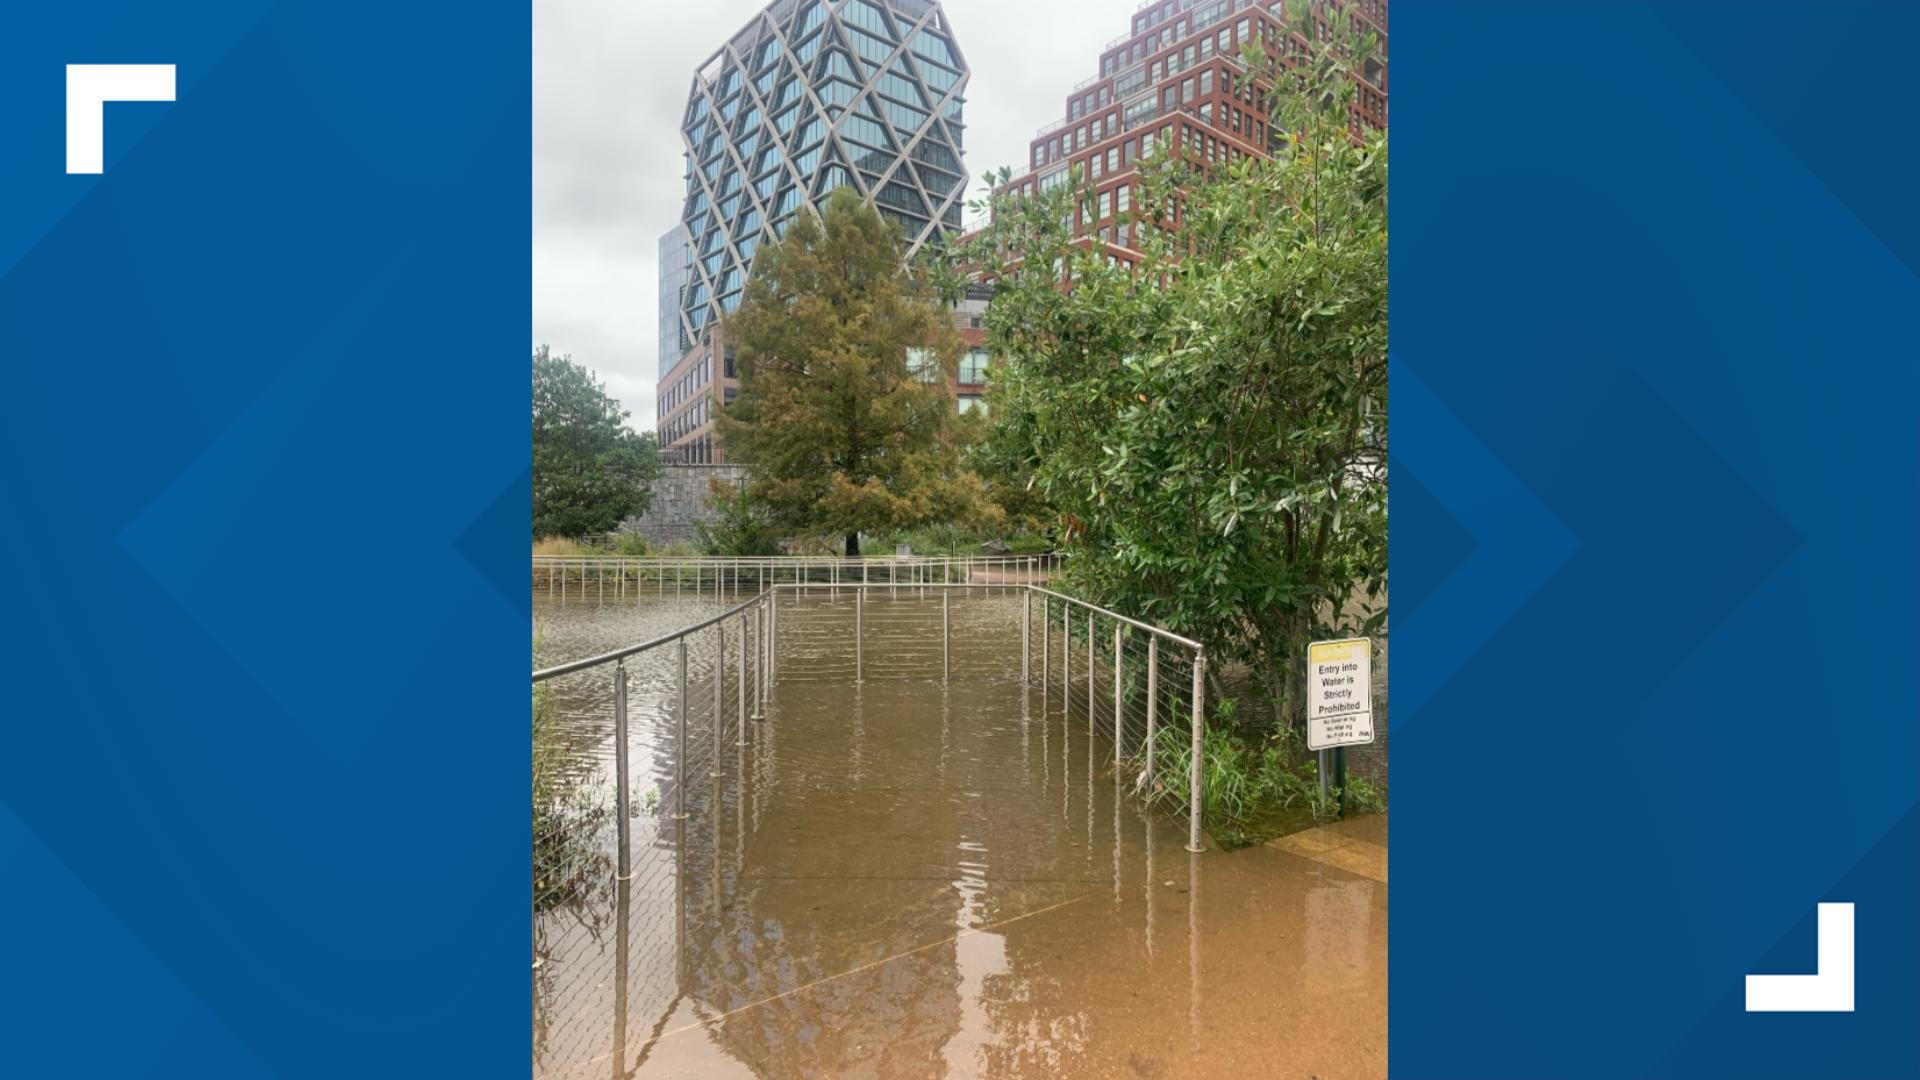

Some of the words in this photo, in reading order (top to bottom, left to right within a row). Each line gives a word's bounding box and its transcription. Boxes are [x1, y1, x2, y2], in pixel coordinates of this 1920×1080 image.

[1319, 665, 1340, 675] Entry
[1342, 663, 1357, 671] into
[1322, 677, 1345, 686] Water
[1347, 675, 1354, 684] is
[1324, 689, 1352, 700] Strictly
[1319, 701, 1360, 714] Prohibited
